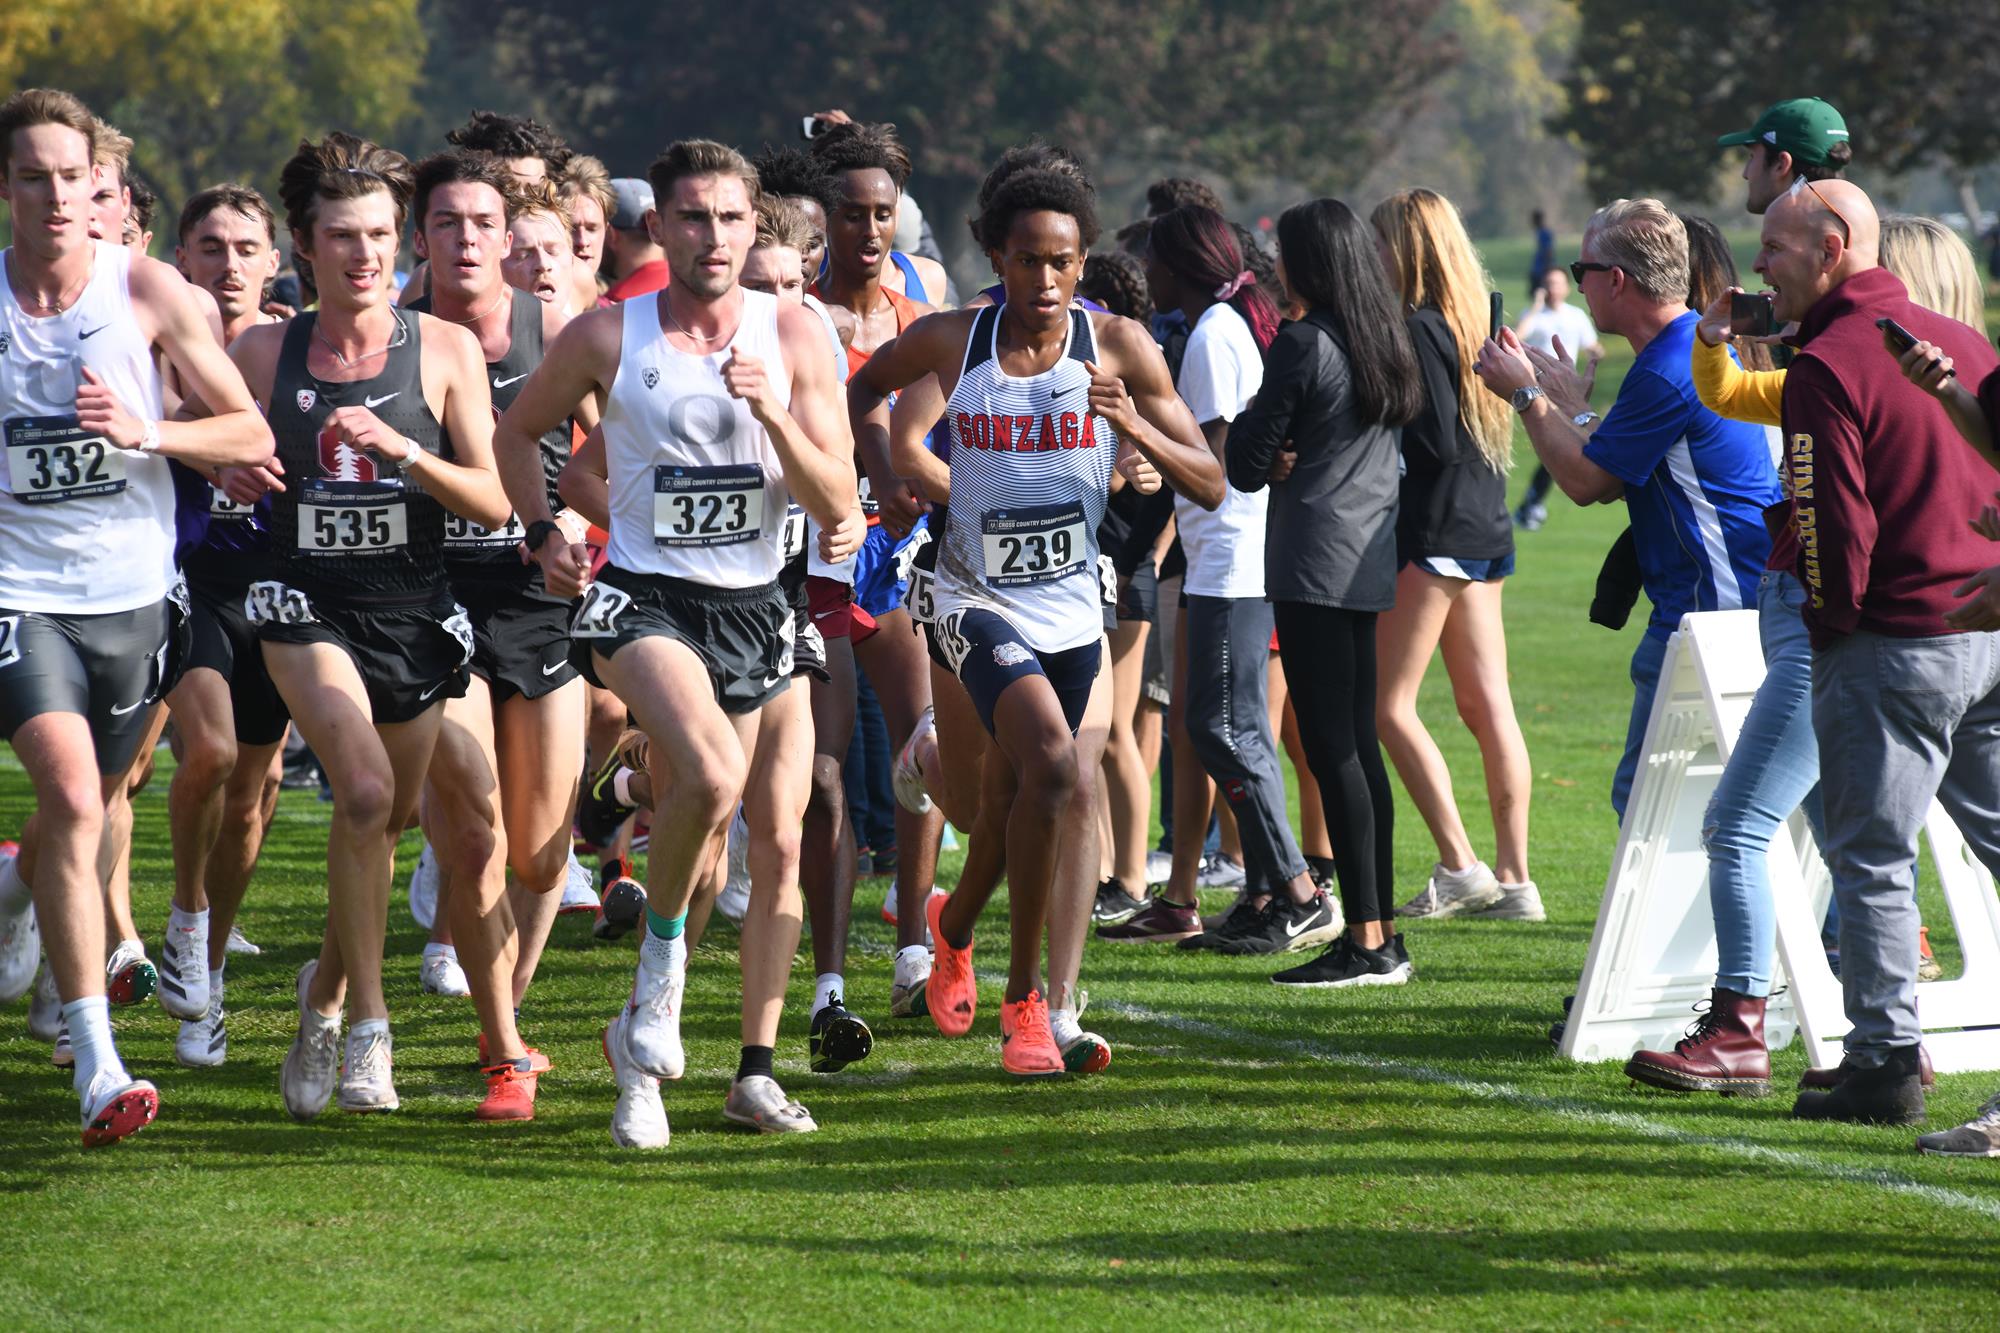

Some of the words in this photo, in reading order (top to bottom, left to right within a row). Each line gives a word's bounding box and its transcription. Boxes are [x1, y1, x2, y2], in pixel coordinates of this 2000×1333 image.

[957, 412, 1096, 452] GONZAGA
[27, 442, 109, 489] 332
[692, 478, 716, 486] COUNTRY
[1791, 433, 1813, 498] SUN
[314, 508, 390, 548] 535
[672, 493, 747, 535] 323
[1016, 519, 1040, 528] COUNTRY
[1040, 511, 1080, 526] CHAMPIONSHIPS
[998, 529, 1071, 574] 239
[1011, 576, 1032, 584] REGIONAL
